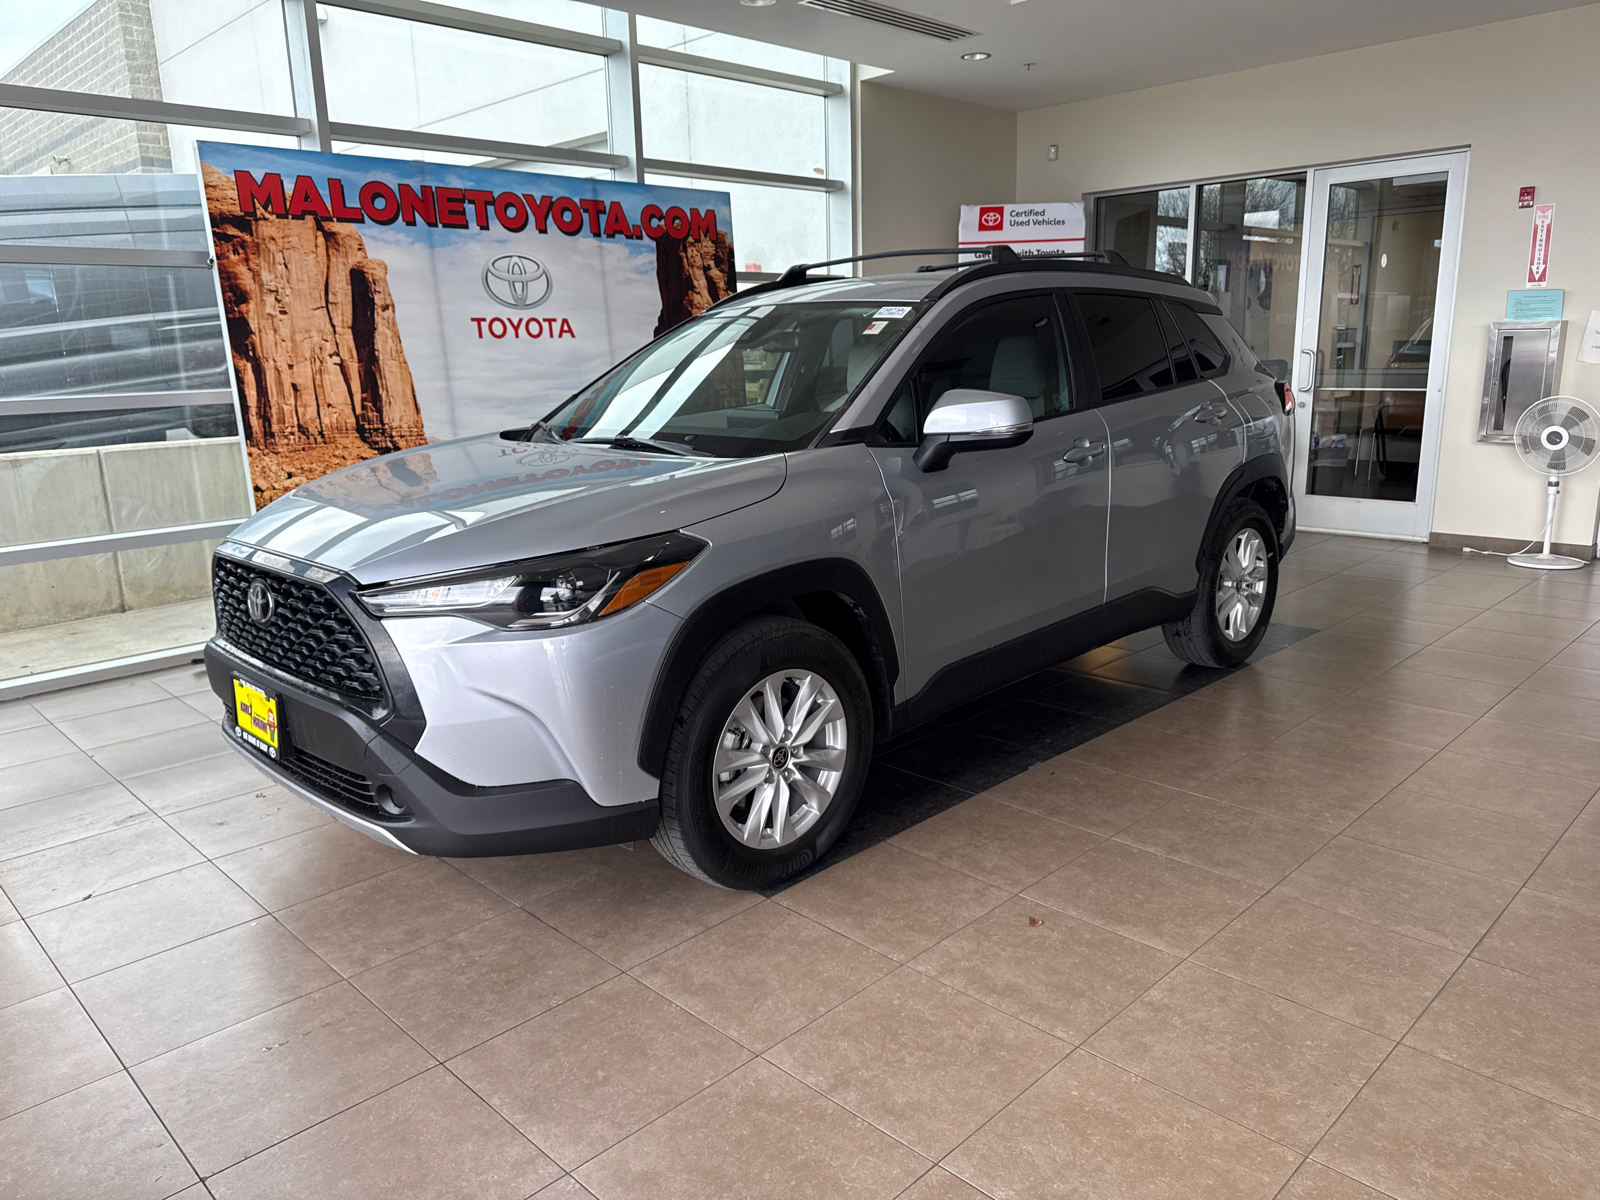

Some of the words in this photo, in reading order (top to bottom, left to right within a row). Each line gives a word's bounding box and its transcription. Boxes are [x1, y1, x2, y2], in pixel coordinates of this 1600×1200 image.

[234, 170, 718, 242] MALONETOYOTA.COM
[1009, 209, 1045, 218] Certified
[1009, 219, 1031, 227] Used
[1032, 217, 1066, 226] Vehicles
[1535, 219, 1545, 275] EXTINGUISHER
[470, 317, 576, 340] TOYOTA
